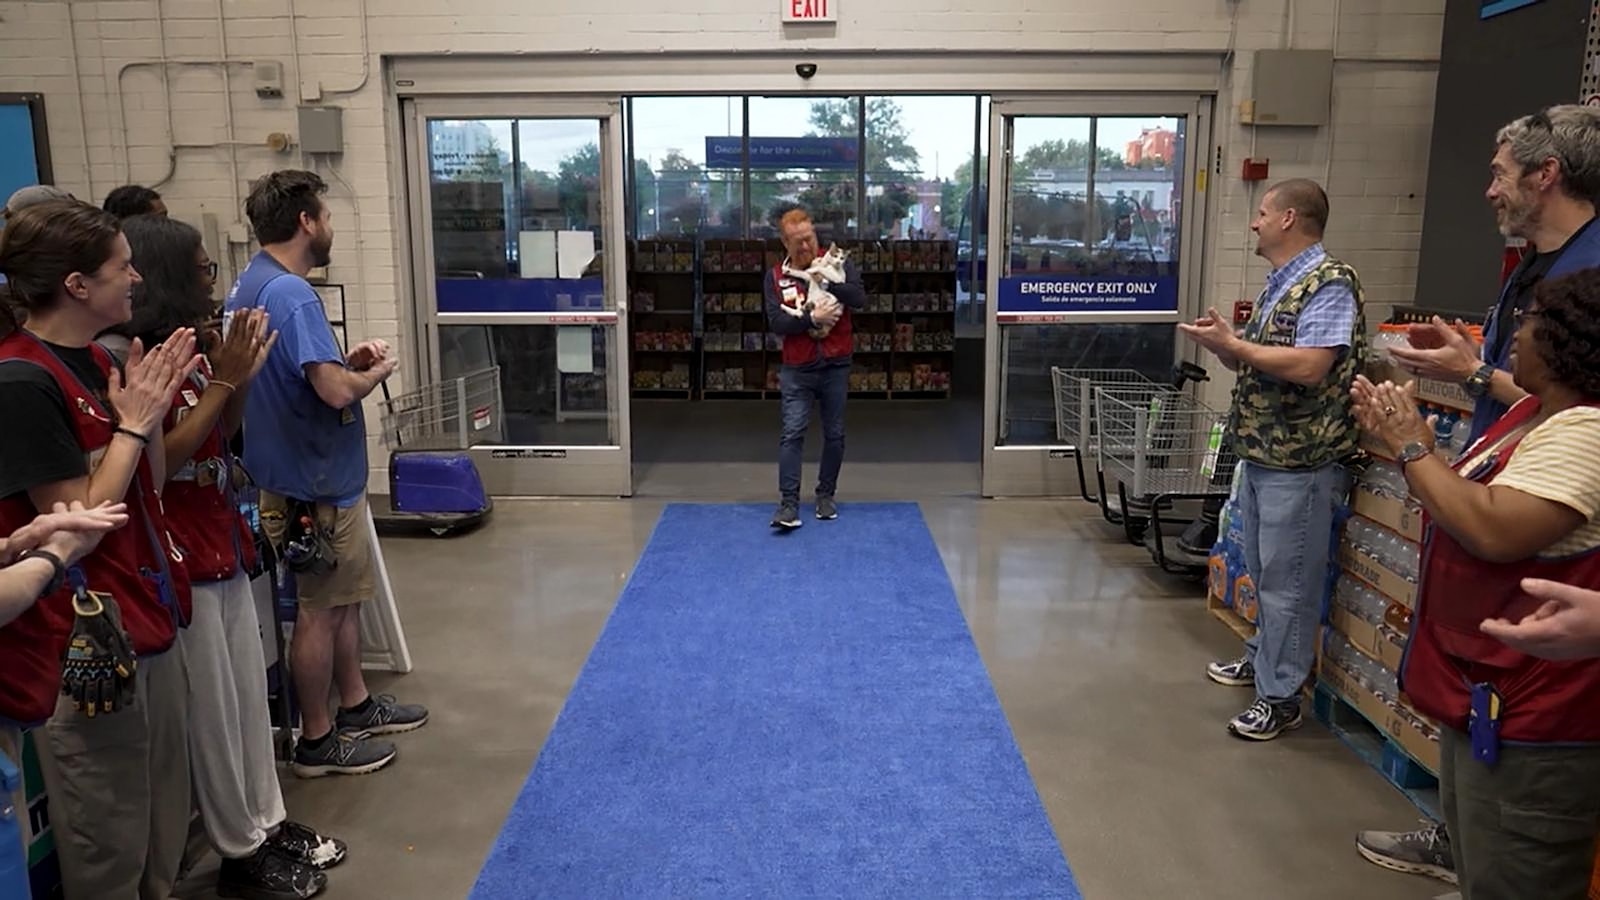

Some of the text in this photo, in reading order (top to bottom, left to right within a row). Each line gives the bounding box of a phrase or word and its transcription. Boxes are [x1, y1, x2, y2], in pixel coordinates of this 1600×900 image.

[792, 0, 828, 17] EXIT
[775, 144, 791, 154] the
[1021, 282, 1157, 294] EMERGENCY EXIT ONLY
